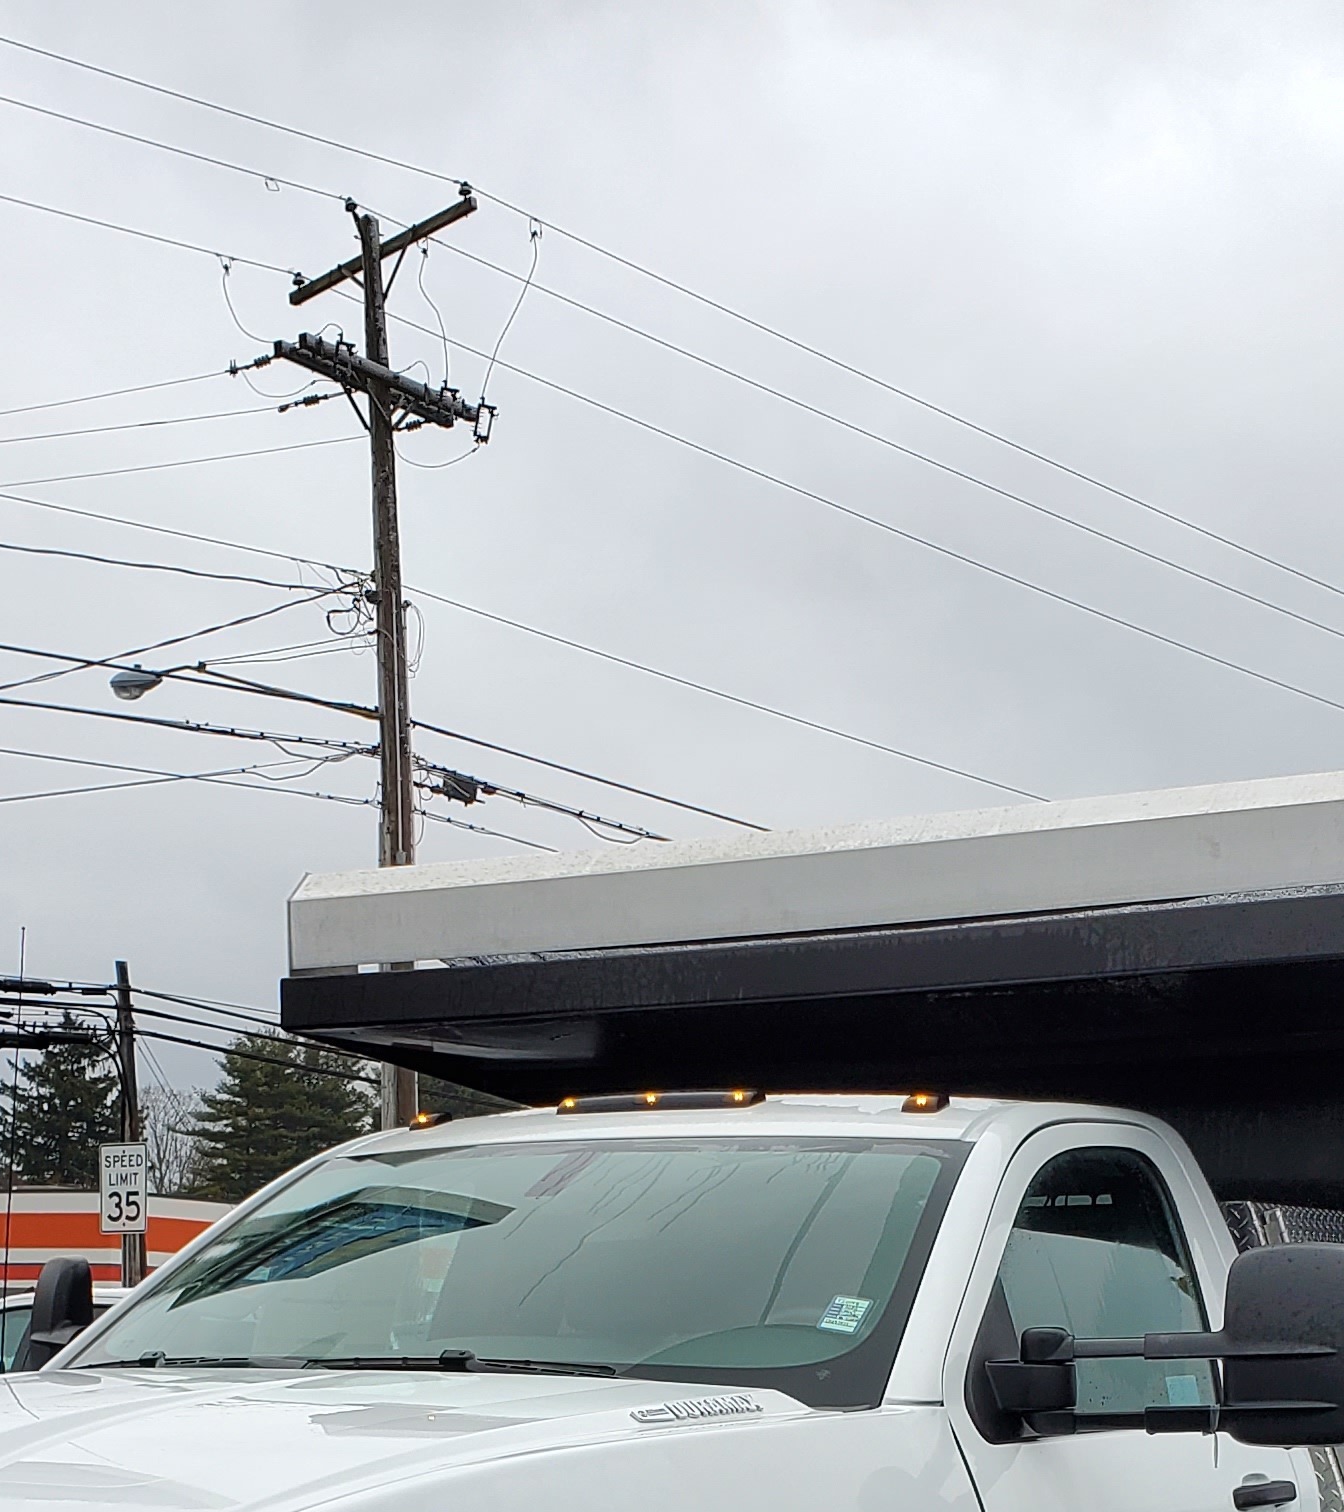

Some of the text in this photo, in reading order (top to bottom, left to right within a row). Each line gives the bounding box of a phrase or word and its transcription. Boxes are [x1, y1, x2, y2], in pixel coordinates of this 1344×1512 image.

[104, 1154, 144, 1168] SPEED
[108, 1173, 139, 1187] LIMIT
[107, 1190, 141, 1222] 35
